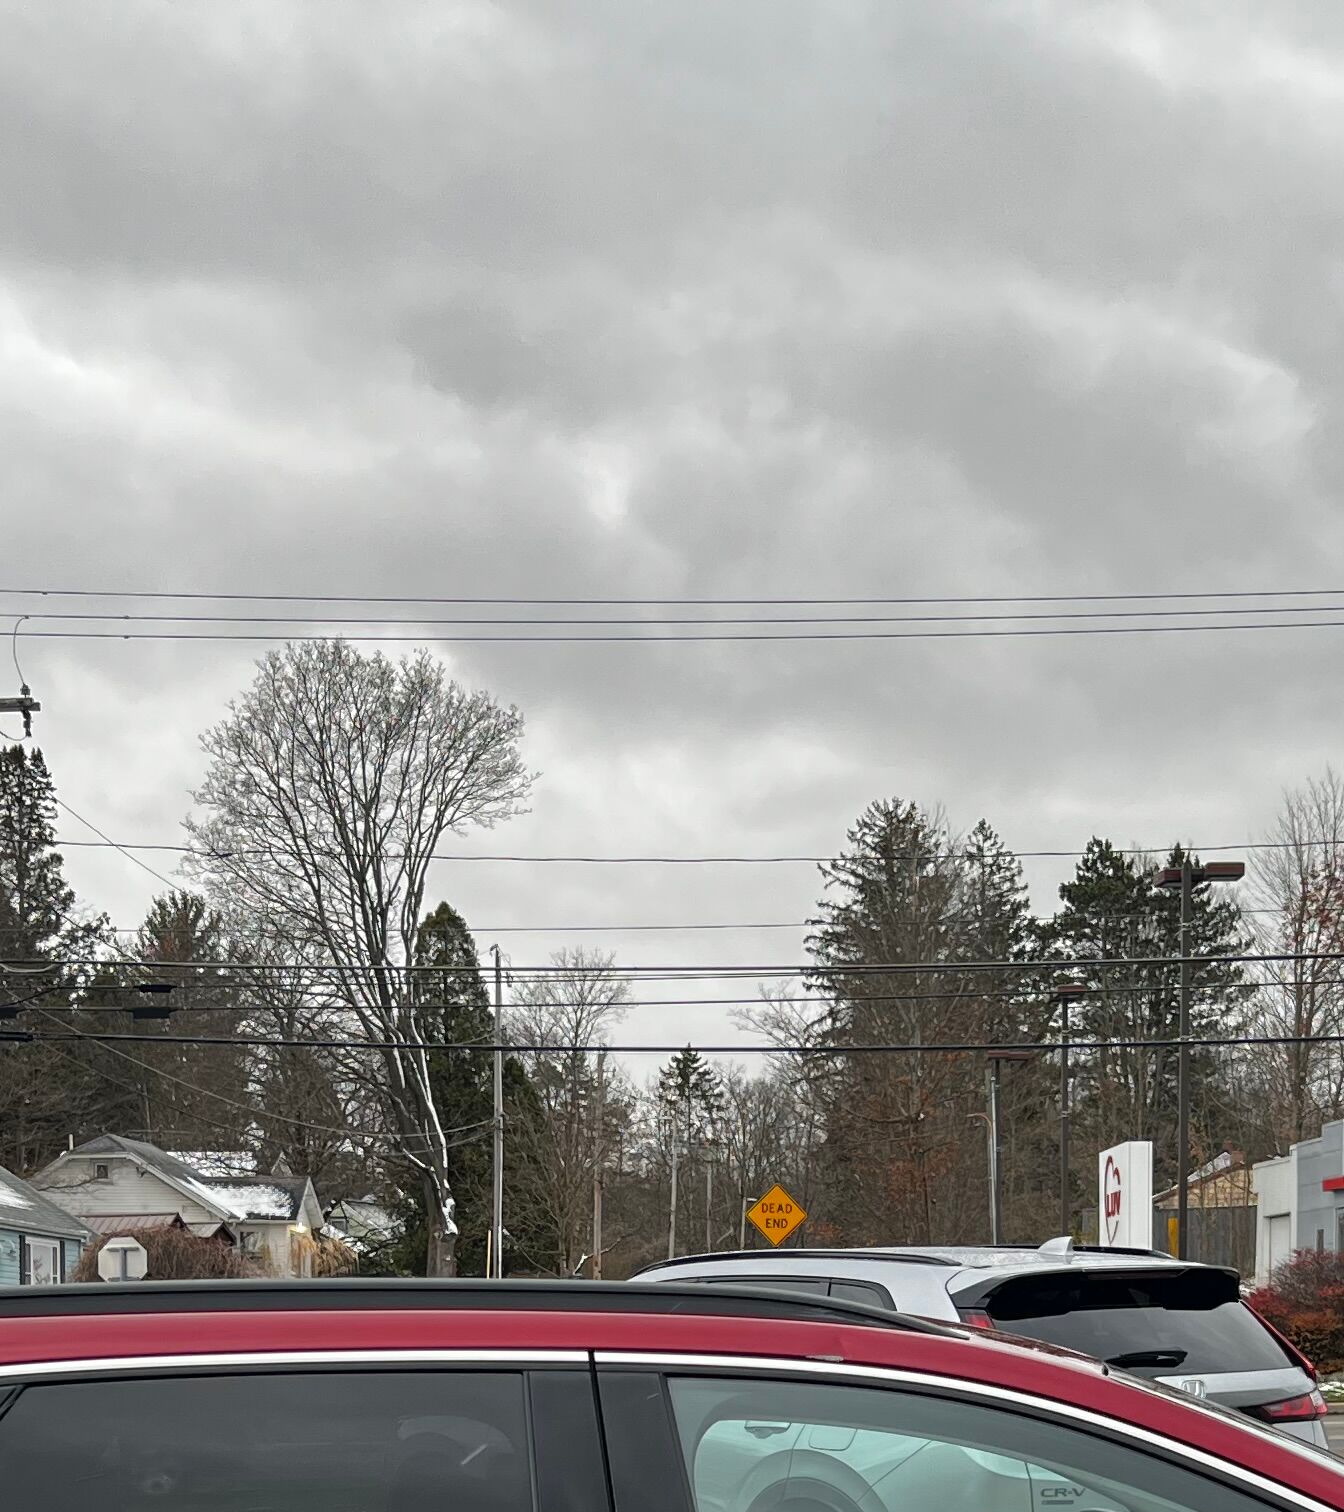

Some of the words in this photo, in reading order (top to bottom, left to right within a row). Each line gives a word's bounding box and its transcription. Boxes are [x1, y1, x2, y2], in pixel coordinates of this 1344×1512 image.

[761, 1203, 792, 1214] DEAD
[765, 1218, 788, 1228] END
[1041, 1488, 1085, 1497] CR-V
